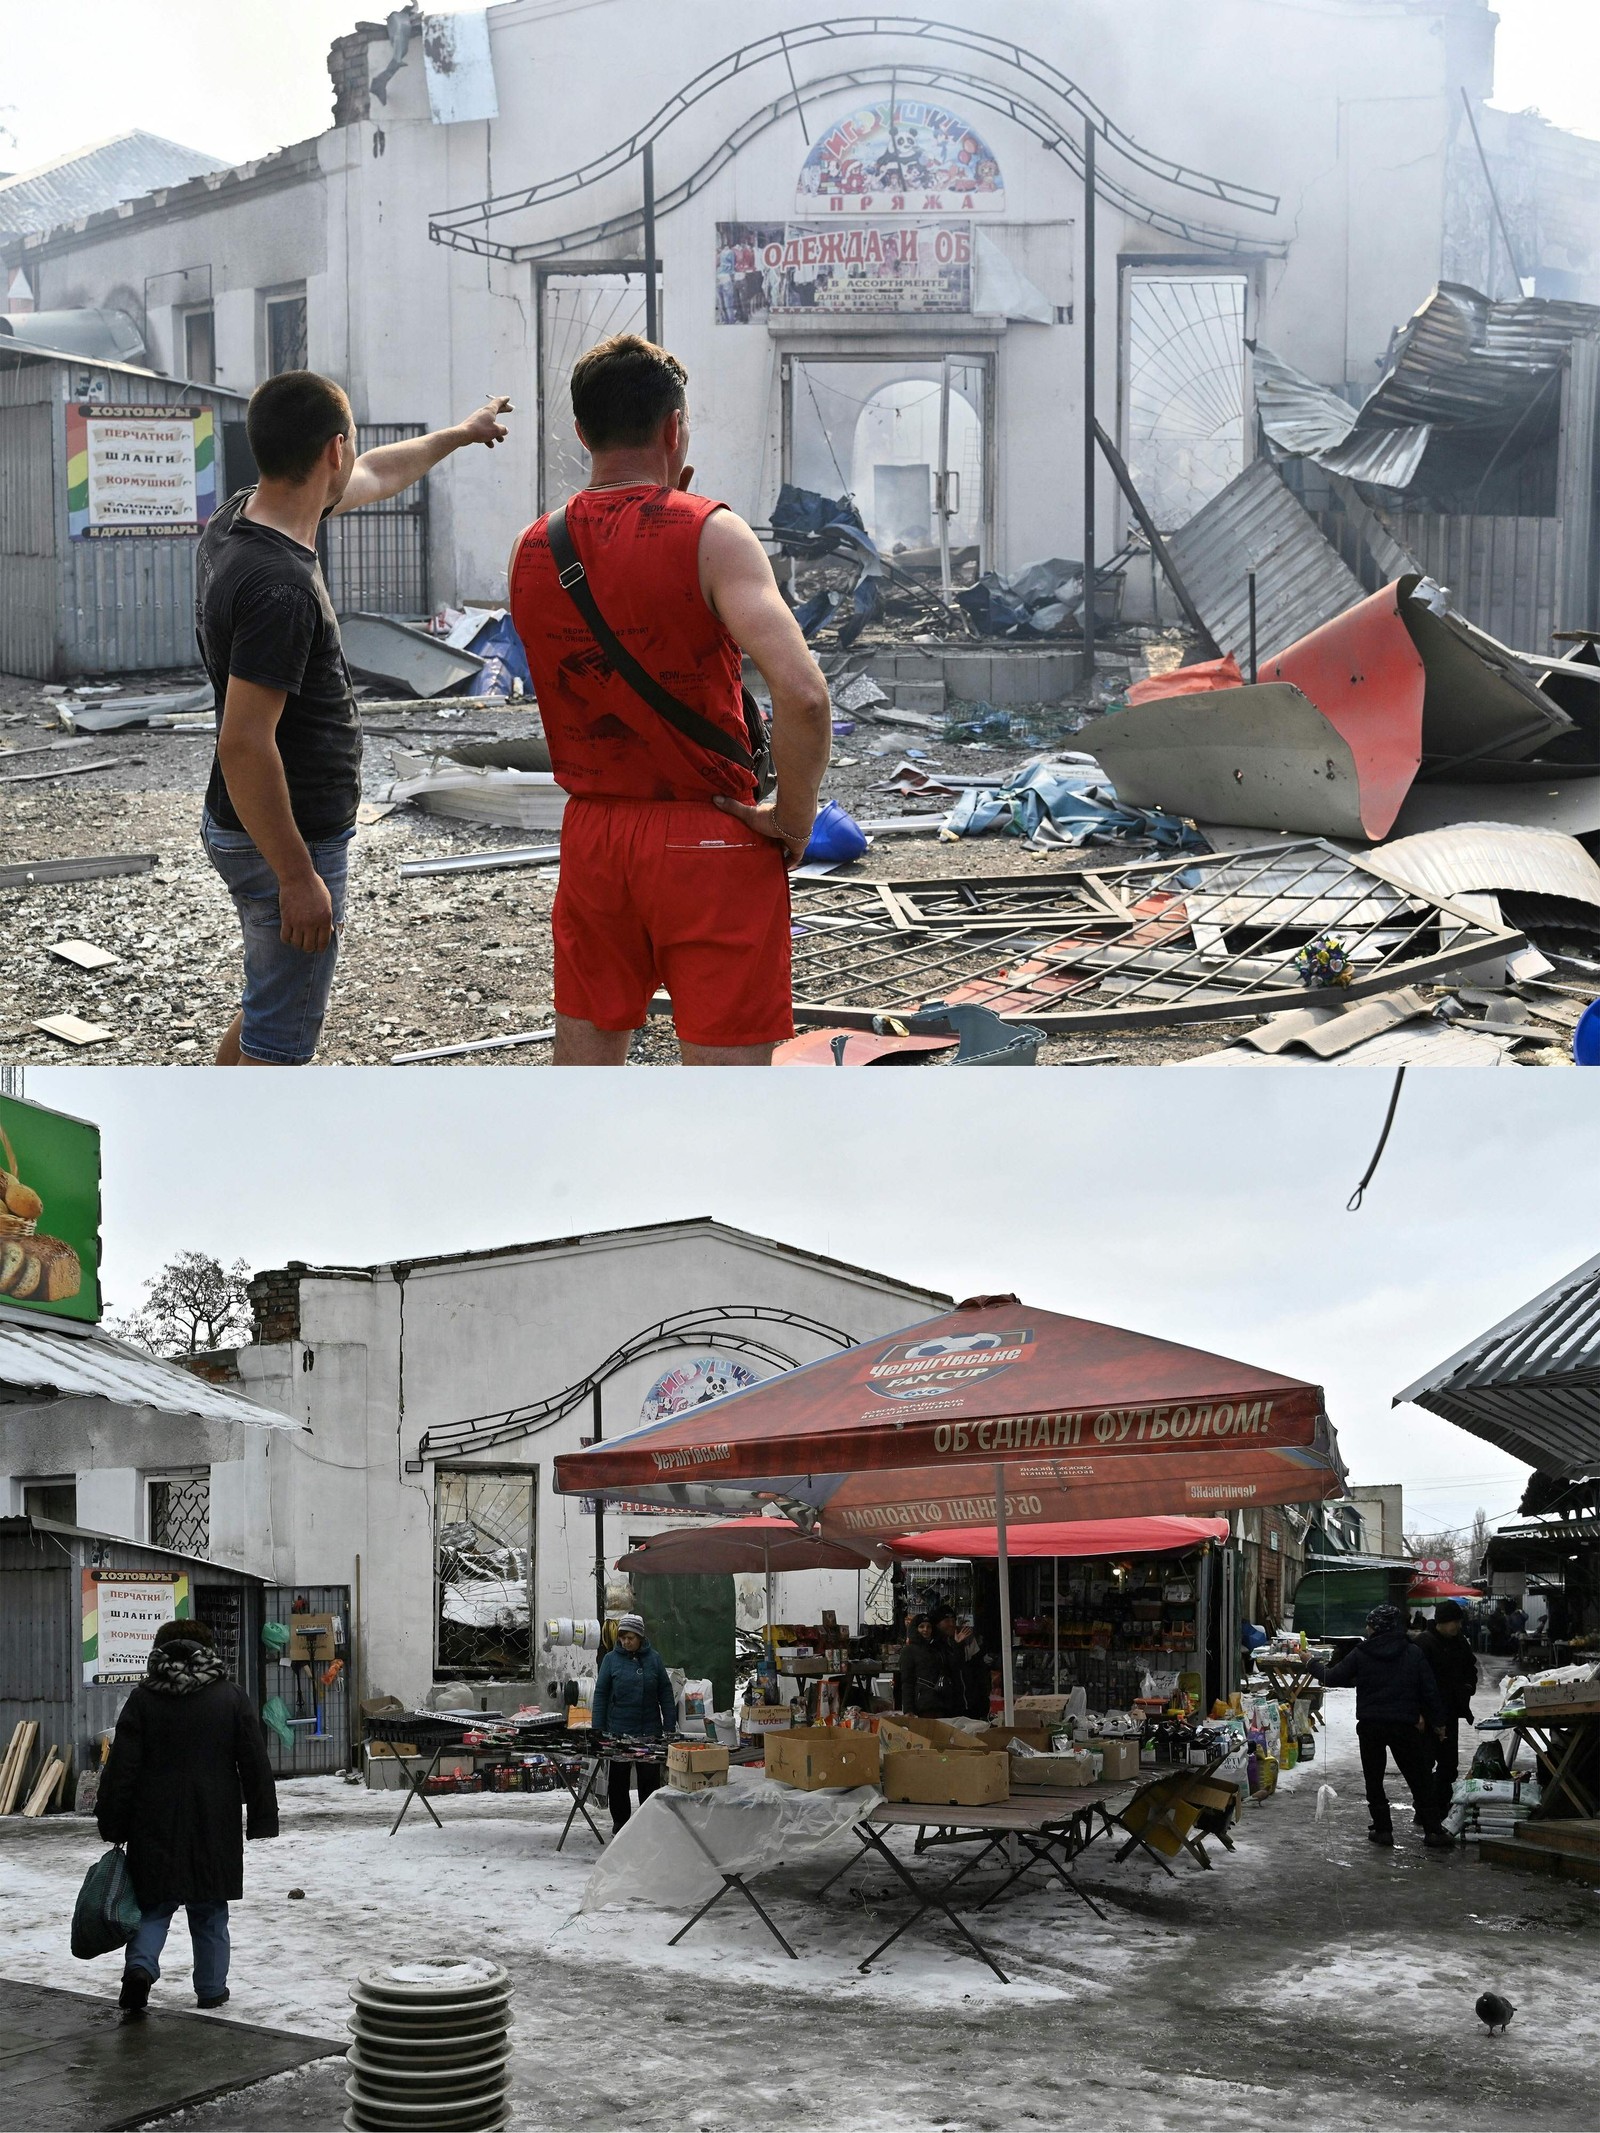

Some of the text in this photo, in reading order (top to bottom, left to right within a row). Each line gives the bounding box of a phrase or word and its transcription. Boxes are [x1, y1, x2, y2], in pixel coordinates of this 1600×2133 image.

[829, 195, 974, 211] ПРЯЖА
[764, 230, 884, 271] ОДЕЖДА
[899, 230, 919, 264] И
[847, 279, 945, 288] АССОРТИМЕНТЕ
[816, 293, 840, 301] ДЛЯ
[843, 293, 904, 301] ВЗРОСЛЫХ
[90, 407, 191, 418] ХОЗТОВАРЫ
[105, 428, 174, 440] ПЕРЧАТКИ
[105, 452, 175, 463] ШЛАНГИ
[106, 476, 175, 487] КОРМУШКИ
[103, 507, 179, 515] ИНВЕНТАРЬ
[90, 525, 198, 537] И ДРУГИЕ ТОВАРЫ
[885, 1367, 989, 1388] FAN CUP
[1093, 1401, 1274, 1445] ФУТБОЛОМ!
[100, 1572, 172, 1581] ХОЗТОВАРЫ
[110, 1590, 160, 1601] ПЕРЧАТКИ
[111, 1610, 161, 1620] ШЛАНГИ
[111, 1631, 156, 1640] КОРМУШК
[107, 1674, 141, 1683] ДРУГИЕ
